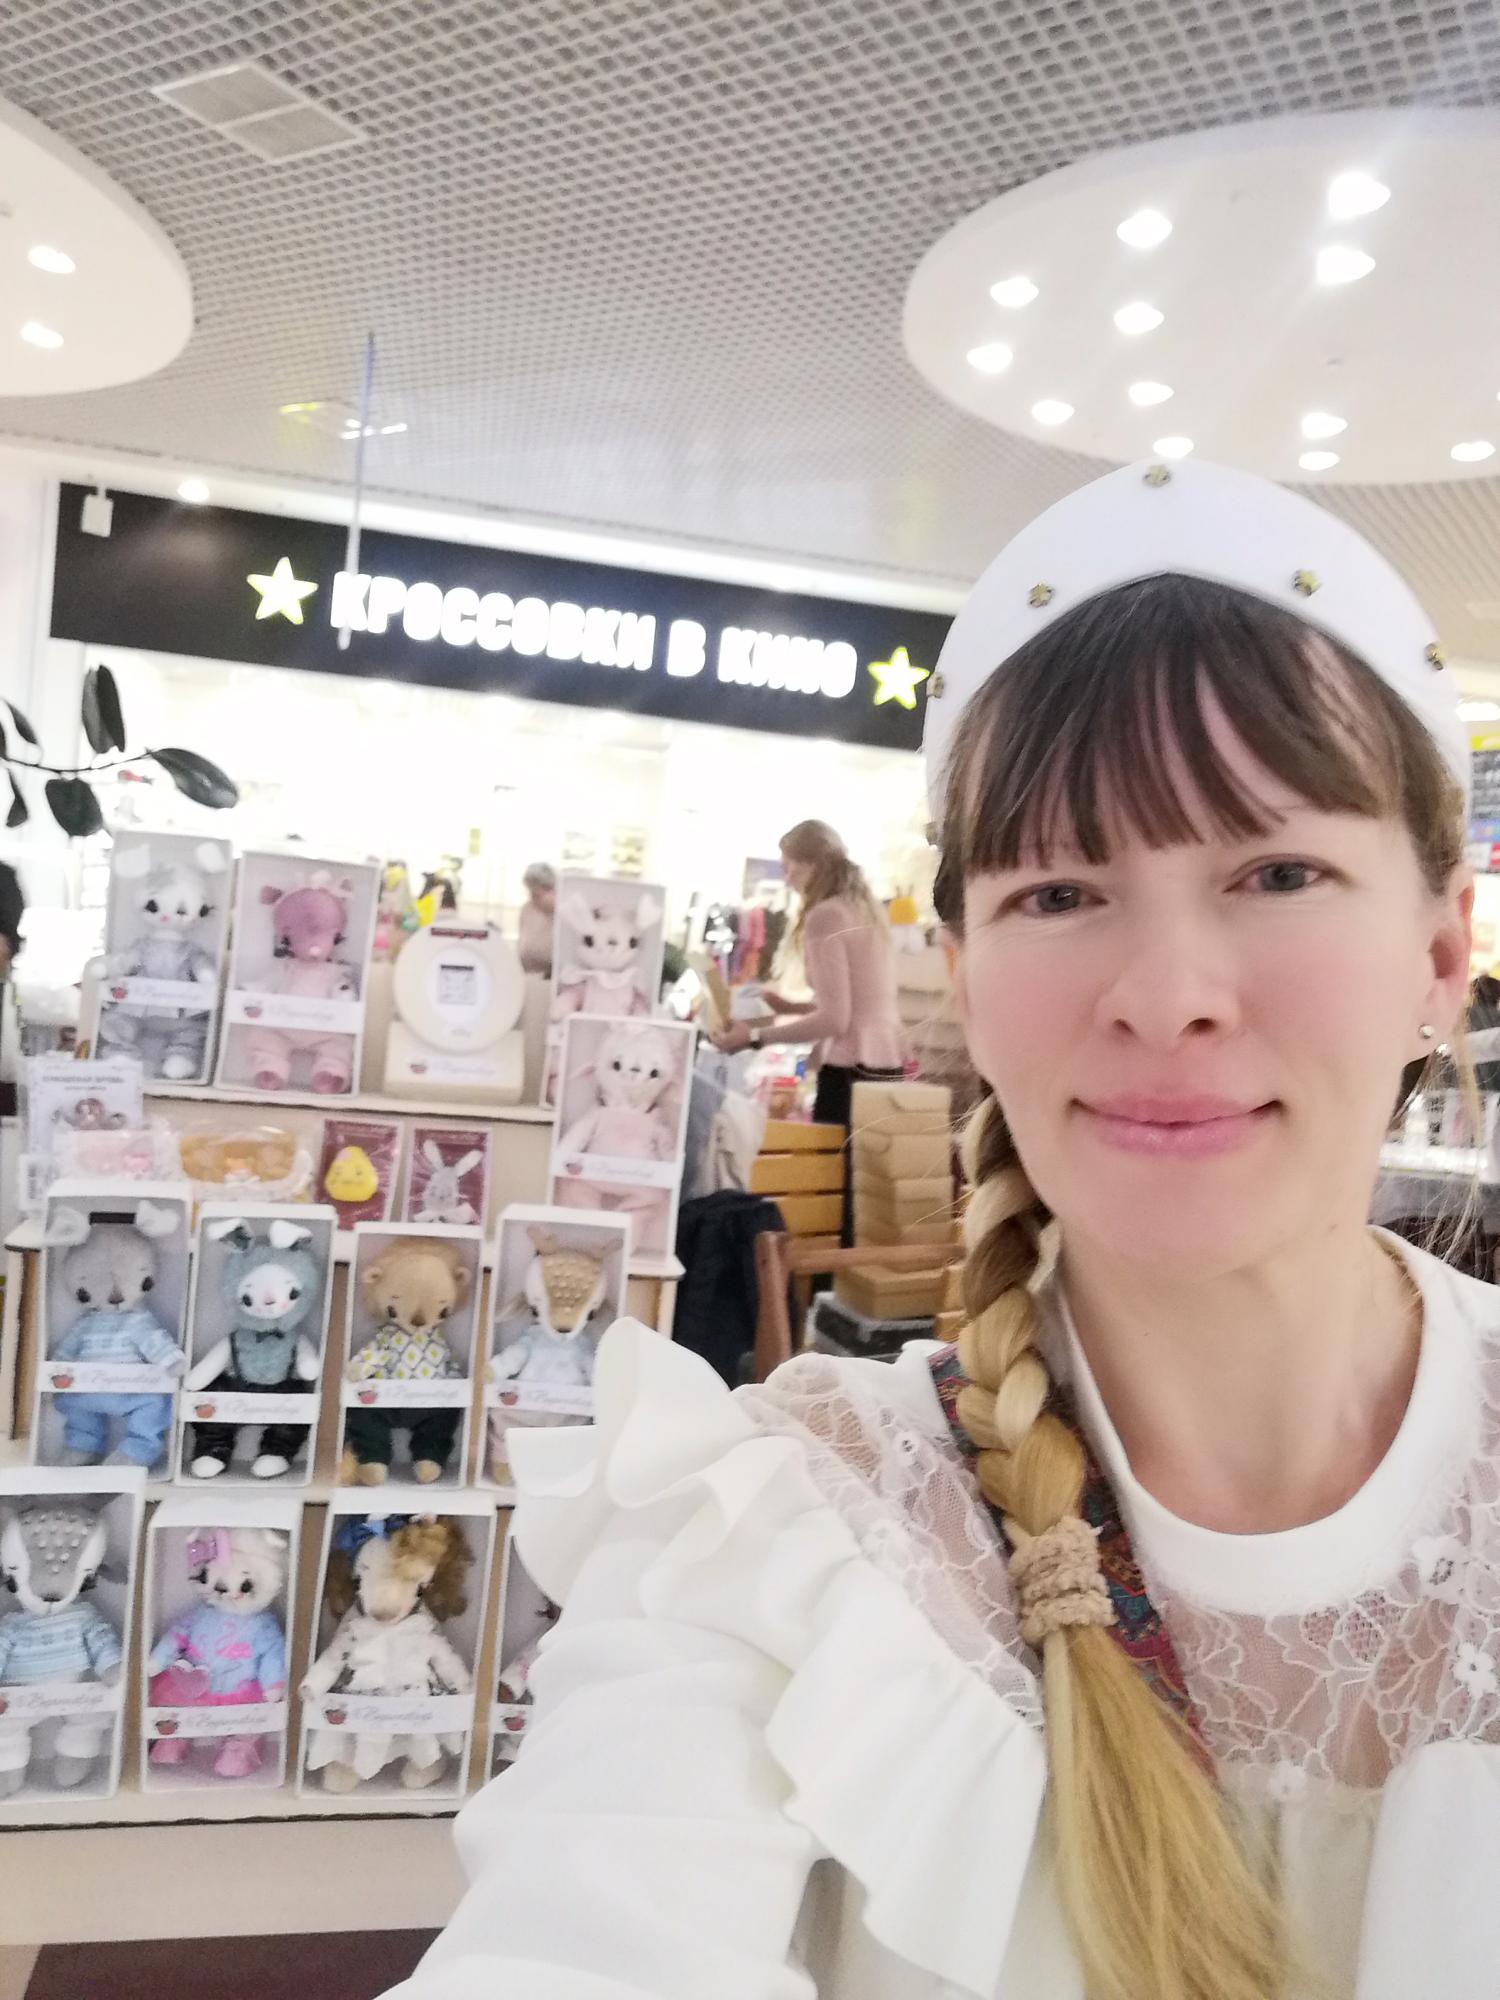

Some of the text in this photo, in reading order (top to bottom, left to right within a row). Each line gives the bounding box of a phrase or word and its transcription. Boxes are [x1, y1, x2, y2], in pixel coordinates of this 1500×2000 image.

[330, 571, 857, 698] КРОССОВКИ В КИНО
